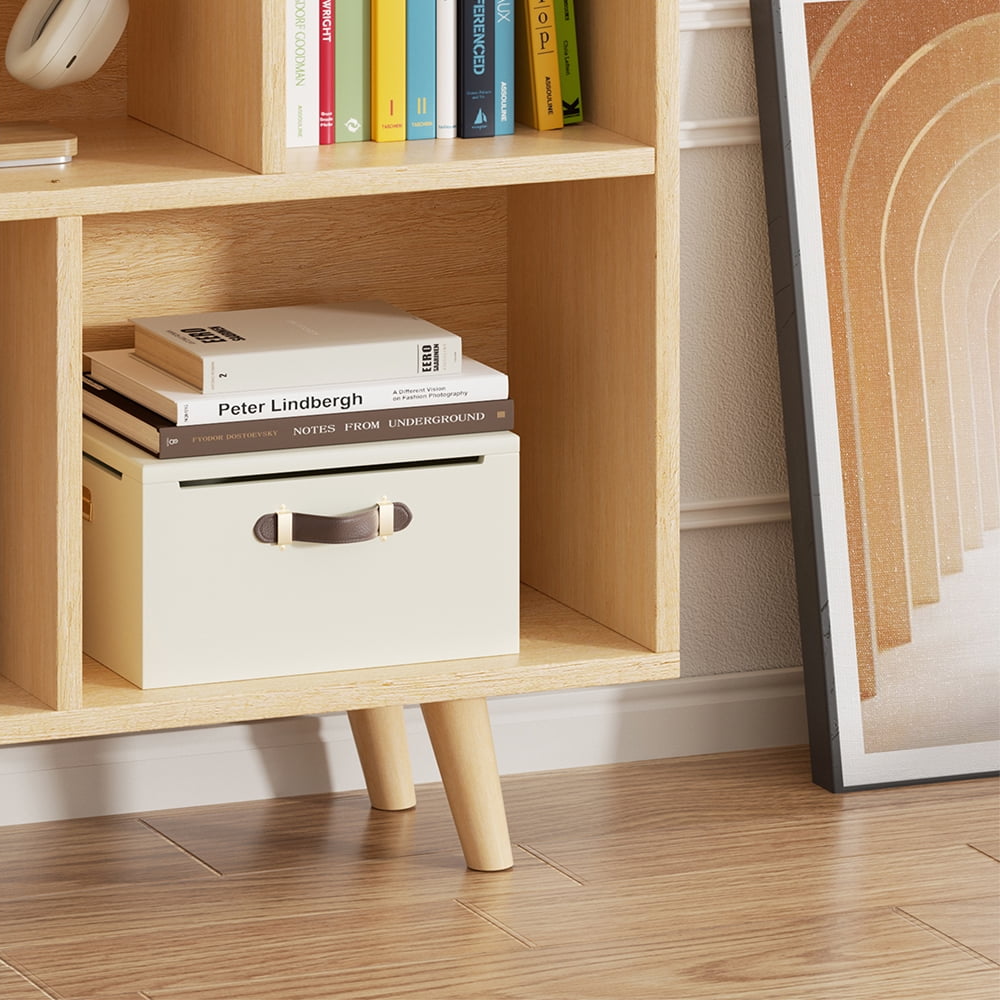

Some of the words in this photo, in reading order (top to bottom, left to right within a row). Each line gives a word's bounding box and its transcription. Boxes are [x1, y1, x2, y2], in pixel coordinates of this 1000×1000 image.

[322, 0, 332, 43] WRIGHT
[295, 32, 305, 87] GOODMAN
[545, 76, 554, 115] ASSOULINE
[422, 345, 432, 372] EERO
[218, 402, 265, 416] Peter
[271, 393, 363, 412] Lindbergh
[428, 391, 468, 399] Photography
[293, 424, 336, 436] NOTES
[345, 420, 380, 432] FROM
[388, 412, 486, 428] UNDERGROUND
[192, 435, 223, 443] FYODOR
[226, 431, 279, 440] DOSTOEVSKY
